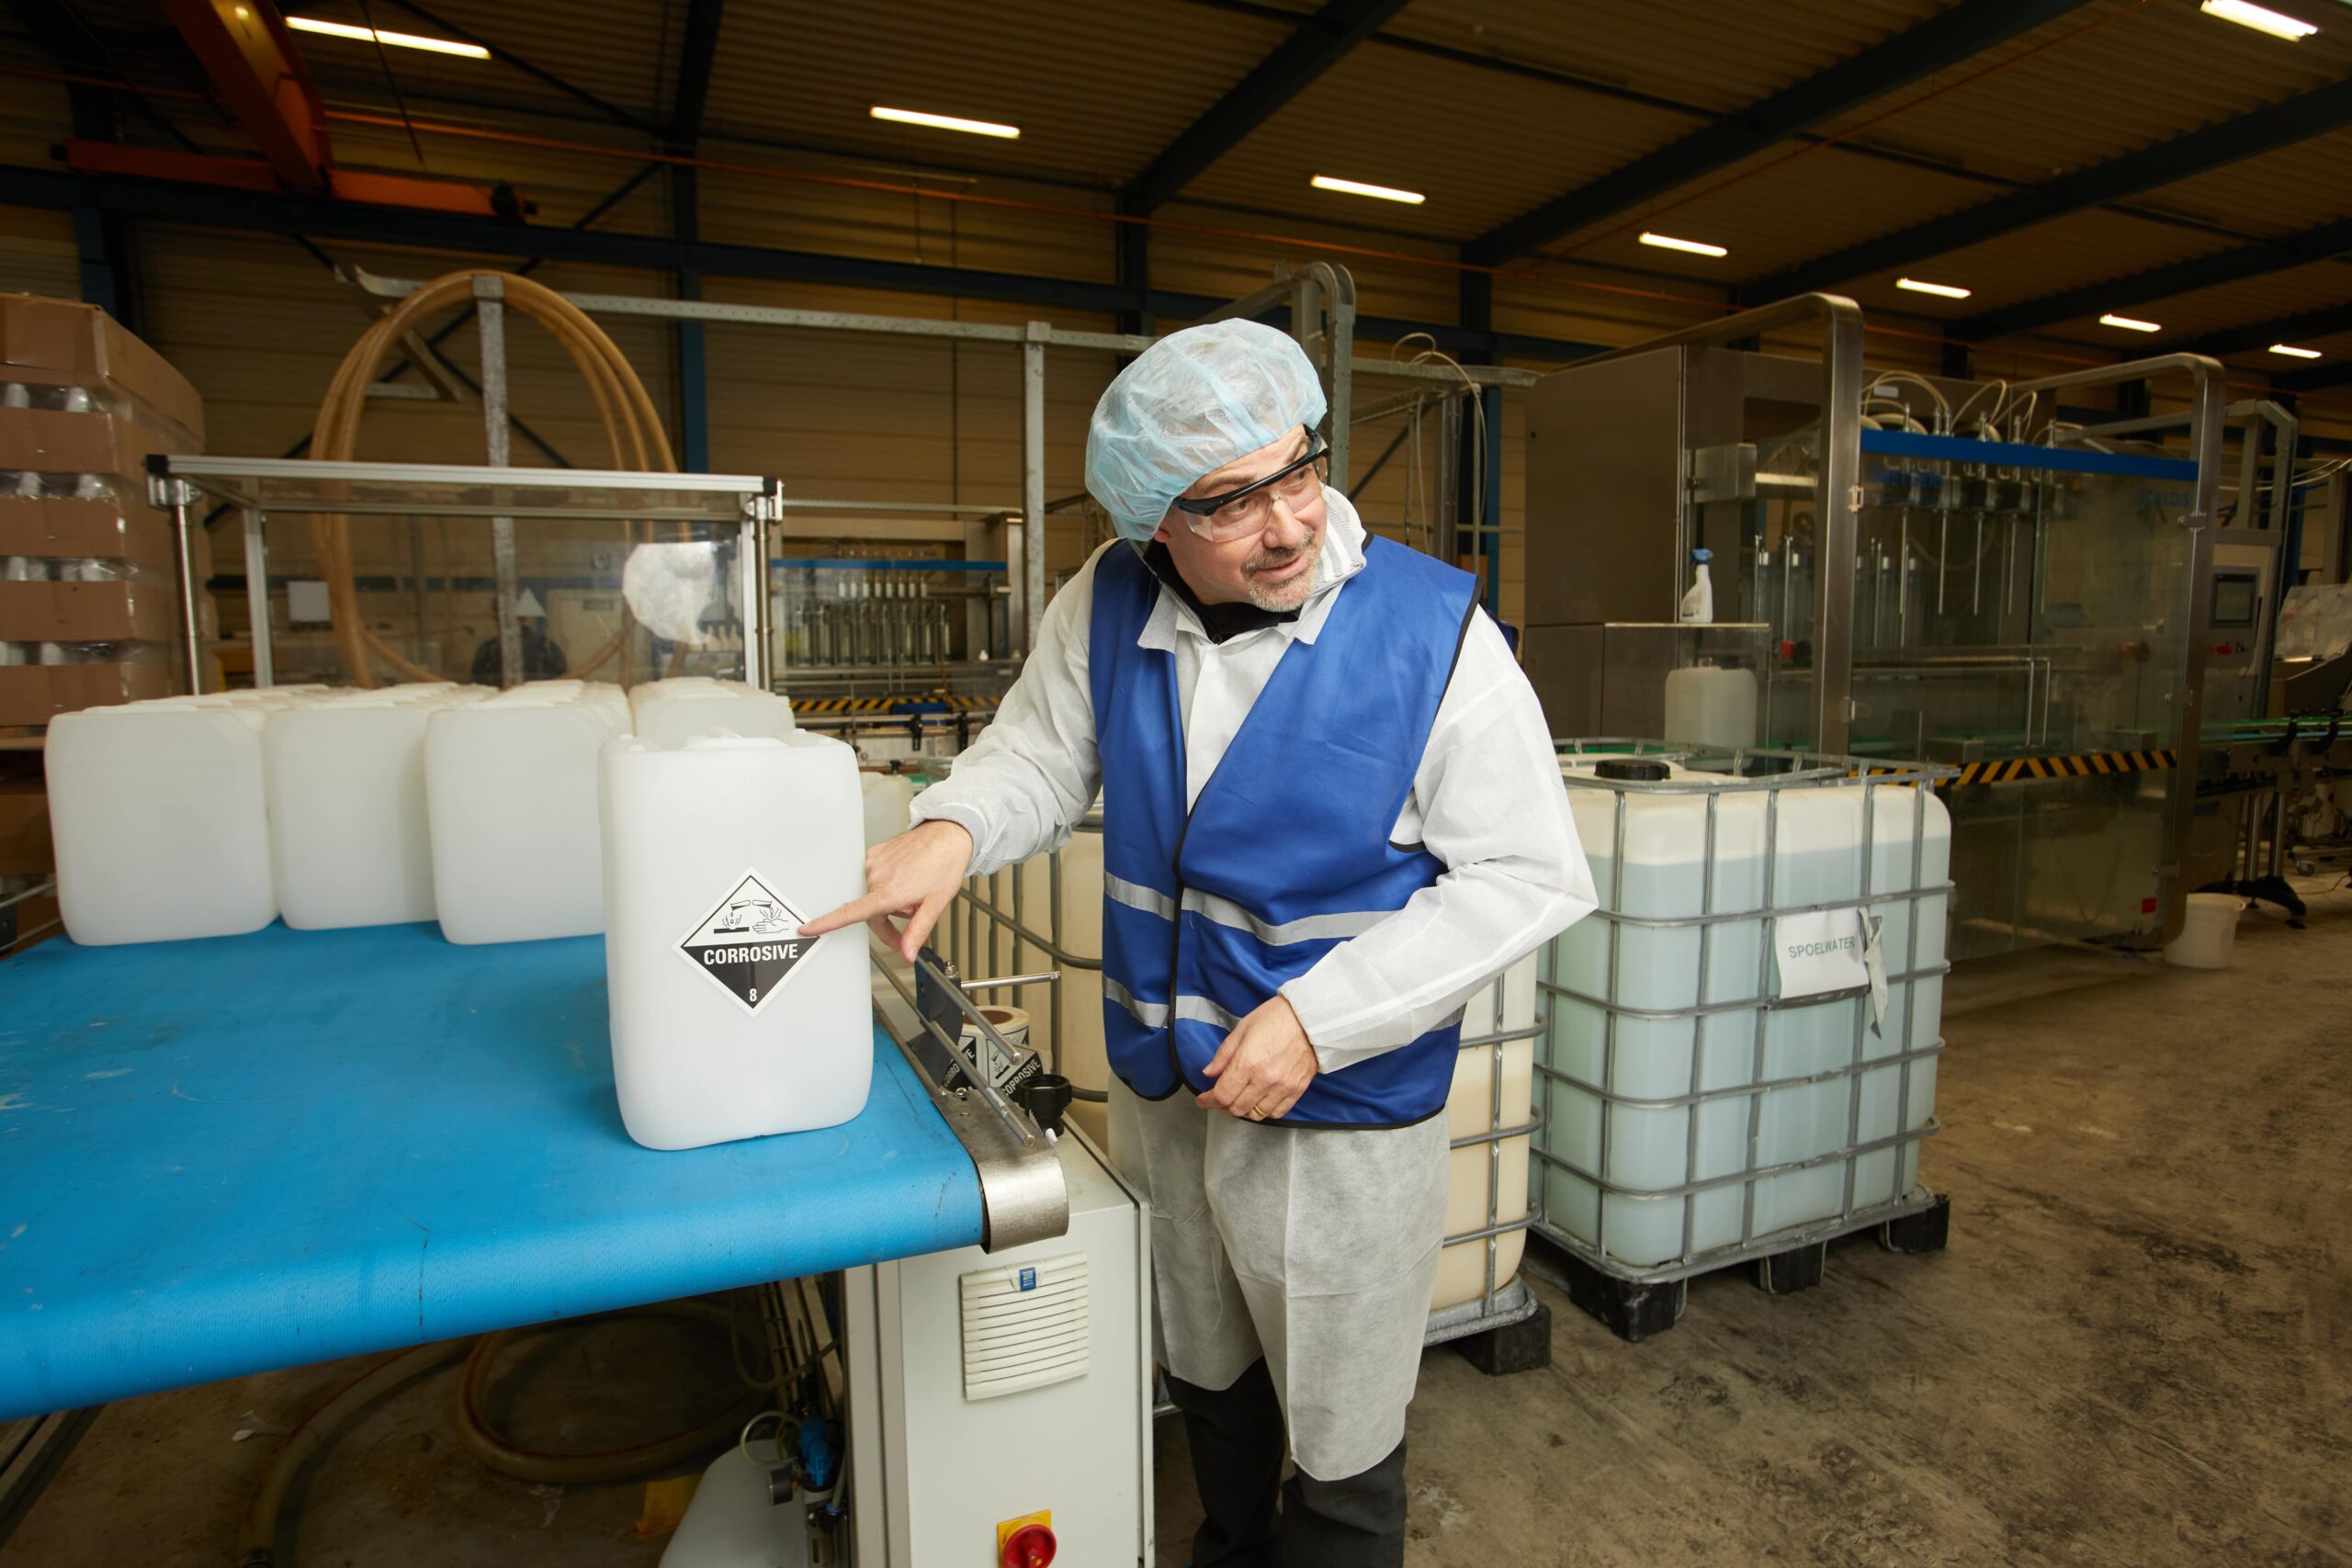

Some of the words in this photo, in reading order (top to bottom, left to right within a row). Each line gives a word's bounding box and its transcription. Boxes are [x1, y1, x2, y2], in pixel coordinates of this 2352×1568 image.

[704, 943, 797, 965] CORROSIVE
[1788, 935, 1855, 959] SPOELWATER
[749, 987, 757, 1002] 8
